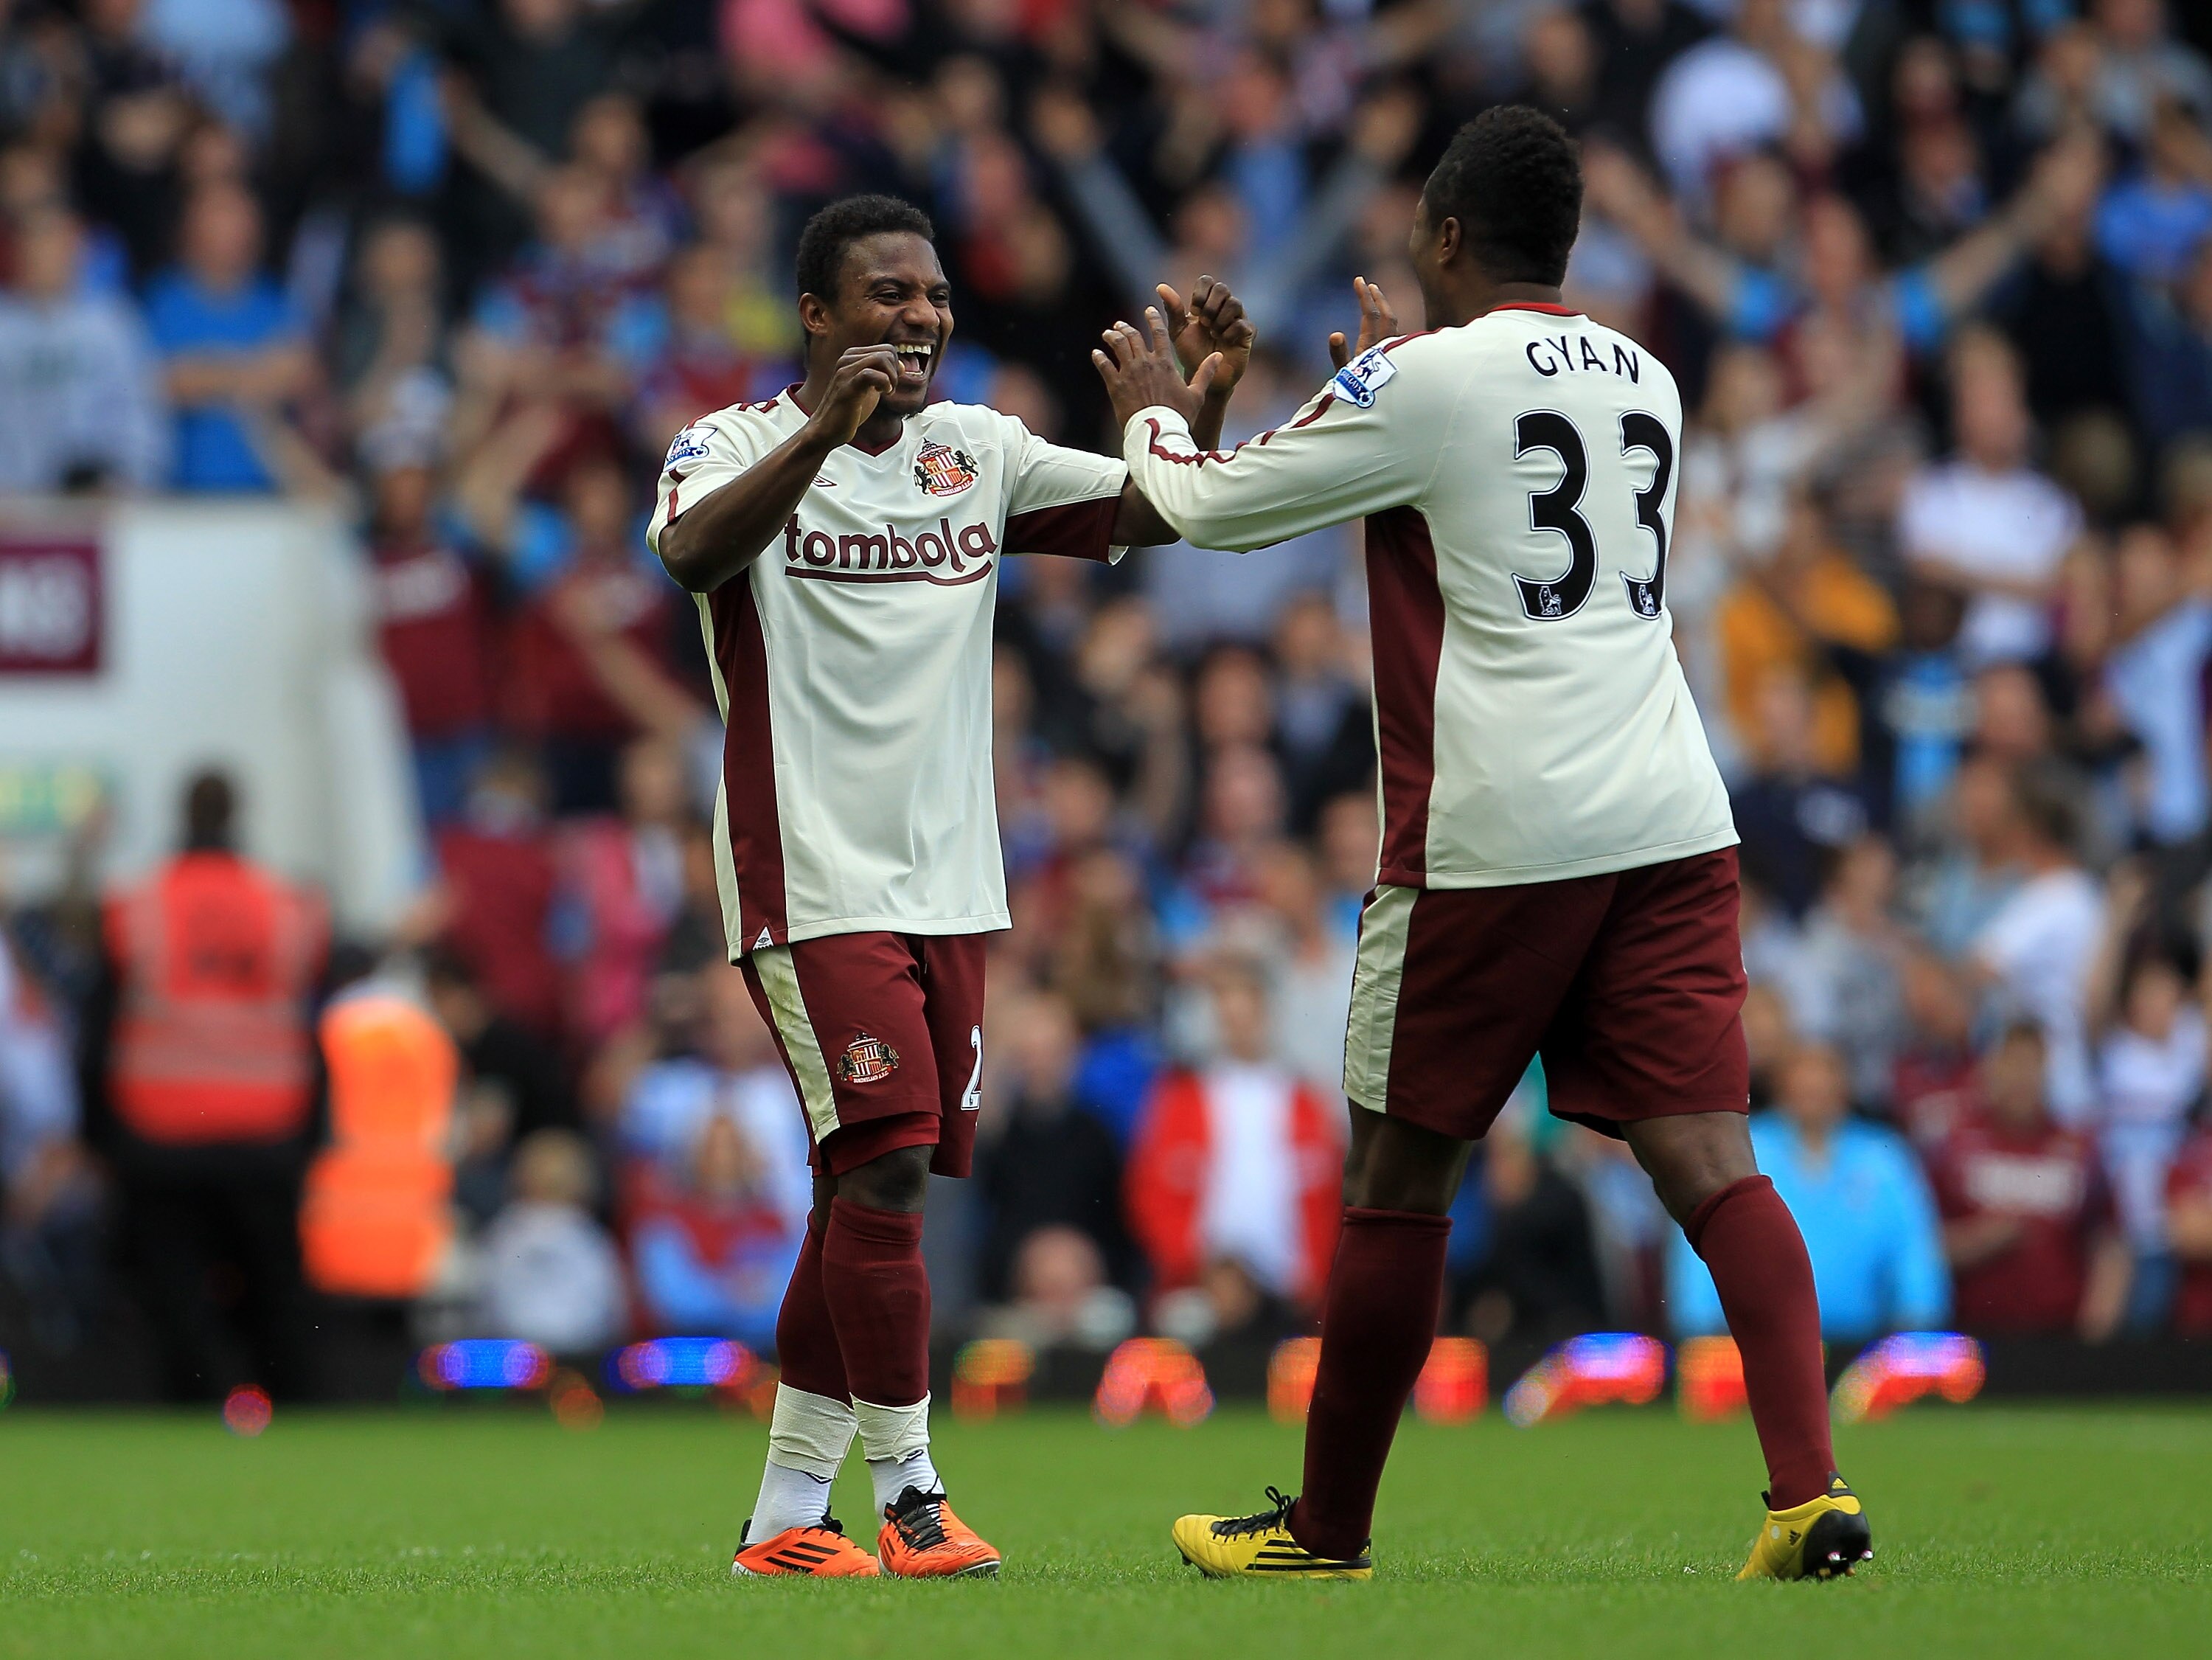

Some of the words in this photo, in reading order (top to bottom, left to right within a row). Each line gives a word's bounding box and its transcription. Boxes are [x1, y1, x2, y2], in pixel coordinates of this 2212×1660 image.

[1526, 335, 1640, 386] GYAN
[784, 513, 999, 573] tombola
[1511, 409, 1673, 621] 33
